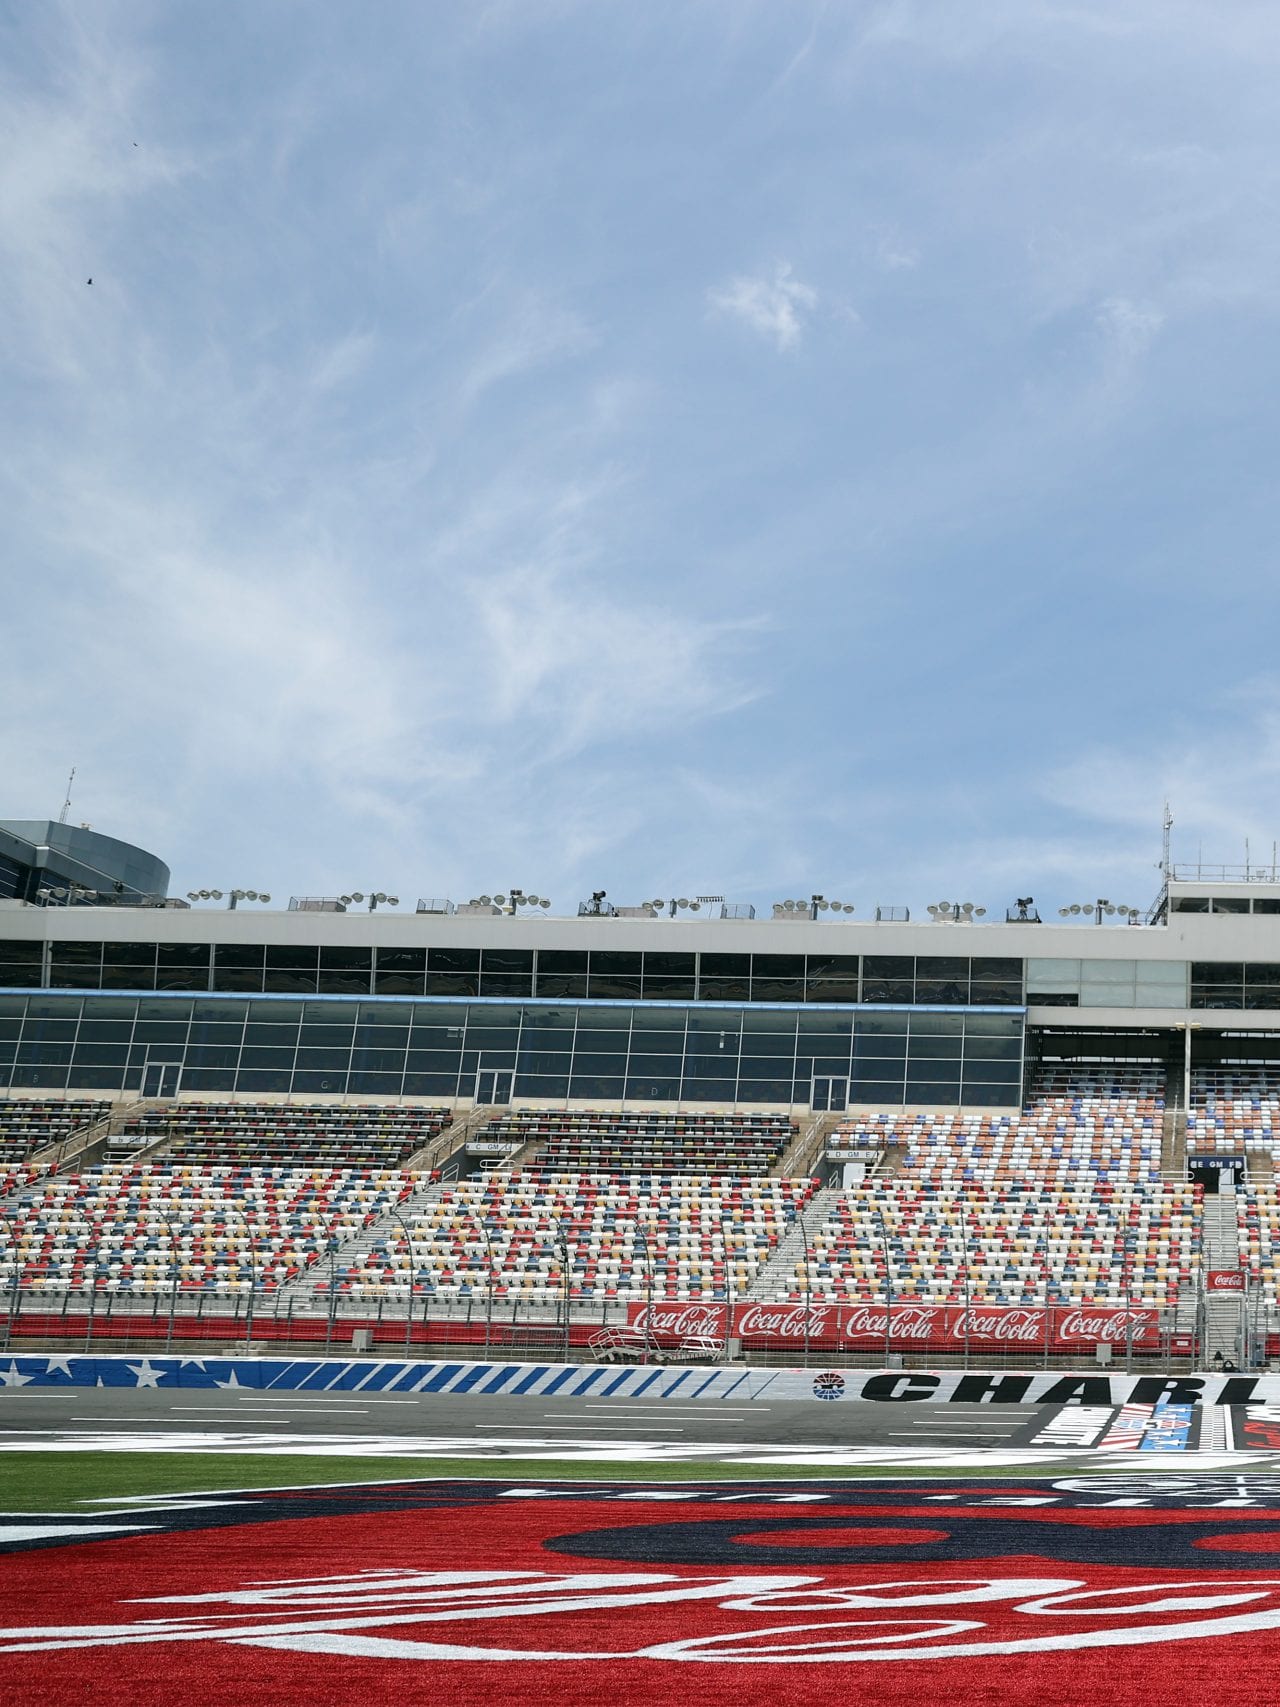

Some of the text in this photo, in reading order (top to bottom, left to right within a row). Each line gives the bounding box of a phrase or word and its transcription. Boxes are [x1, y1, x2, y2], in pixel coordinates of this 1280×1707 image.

[651, 1087, 658, 1096] D
[1214, 1274, 1243, 1286] Coca-Cola
[738, 1304, 827, 1338] Coca-Cola
[845, 1306, 934, 1339] Coca-Cola
[952, 1308, 1041, 1341] Coca-Cola
[1059, 1309, 1147, 1342] Coca-Cola
[494, 1488, 833, 1502] USA
